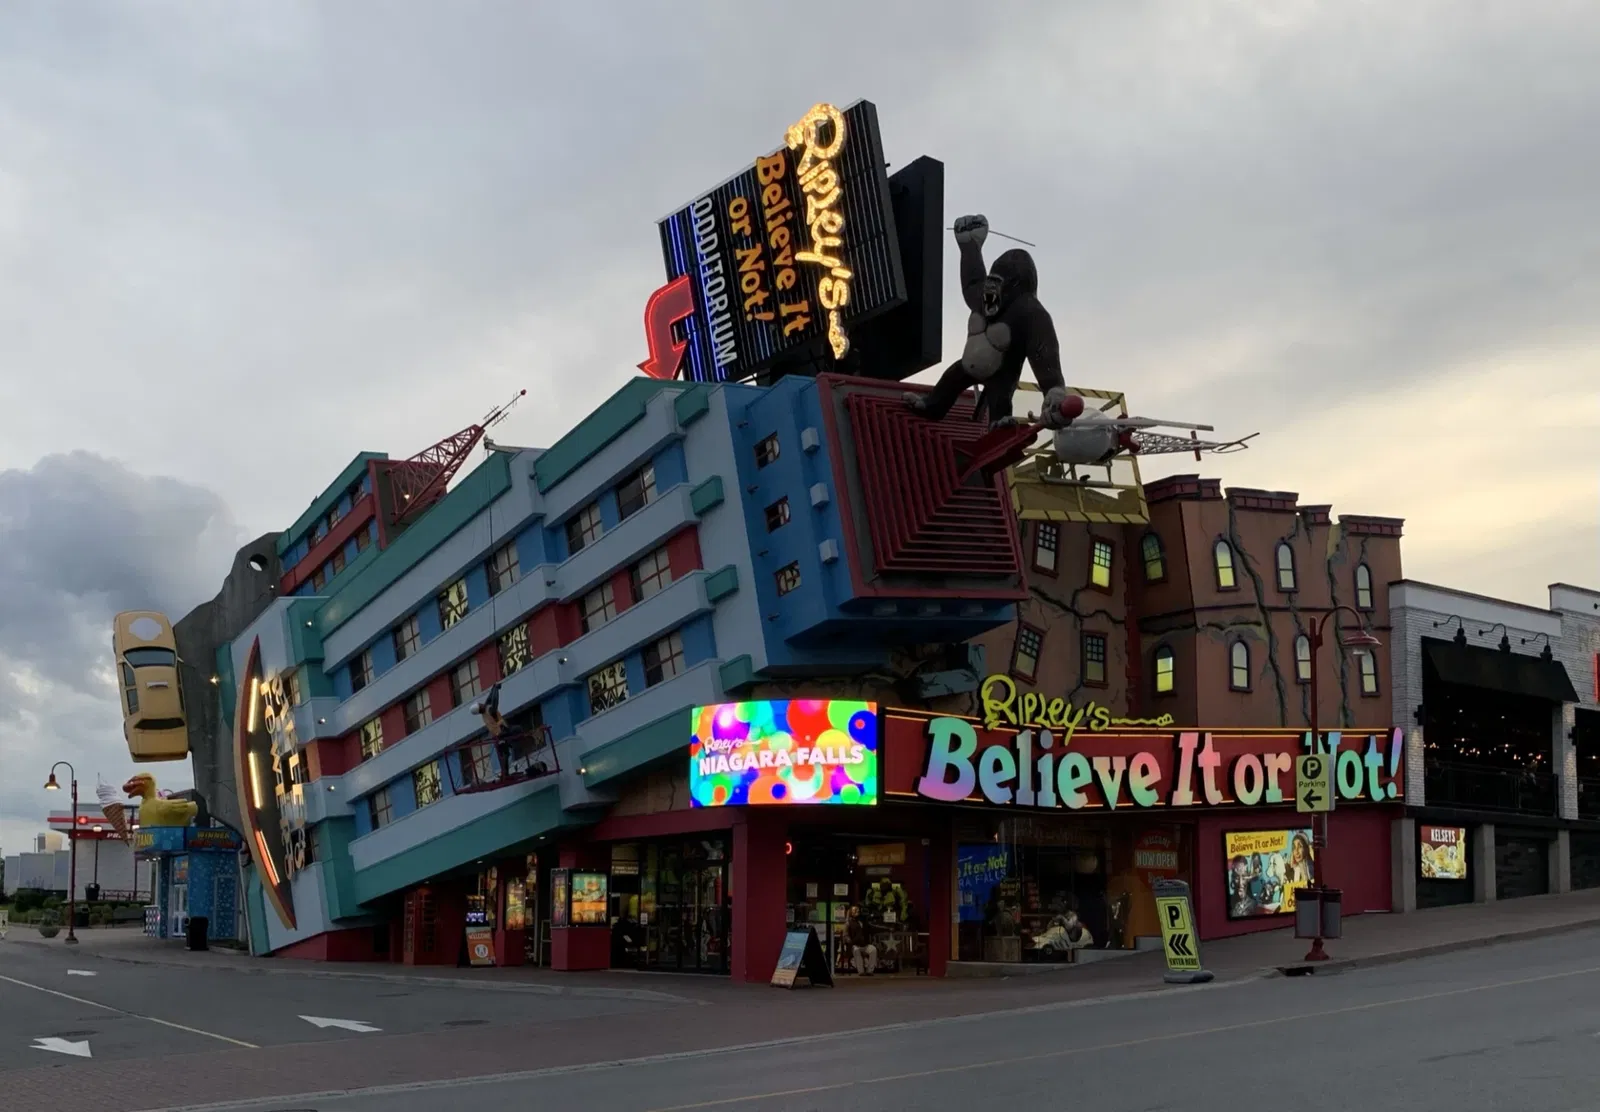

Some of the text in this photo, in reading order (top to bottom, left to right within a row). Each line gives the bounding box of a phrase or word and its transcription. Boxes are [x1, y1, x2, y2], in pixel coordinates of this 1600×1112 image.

[784, 102, 853, 360] Ripley's
[756, 151, 813, 336] Believe It
[729, 196, 775, 322] or Not!
[694, 197, 737, 366] ODDITORIUM
[699, 744, 864, 776] NIAGARA FALLS
[917, 716, 1162, 810] Believe
[1172, 732, 1221, 806] It
[1234, 752, 1292, 805] or
[1305, 759, 1319, 777] P
[1299, 780, 1326, 788] Parking
[1230, 836, 1284, 853] Believe It or Not!
[1431, 829, 1456, 843] KELSEYS
[987, 851, 1008, 868] Not!
[1136, 852, 1176, 867] NOW OPEN
[1167, 904, 1181, 927] P
